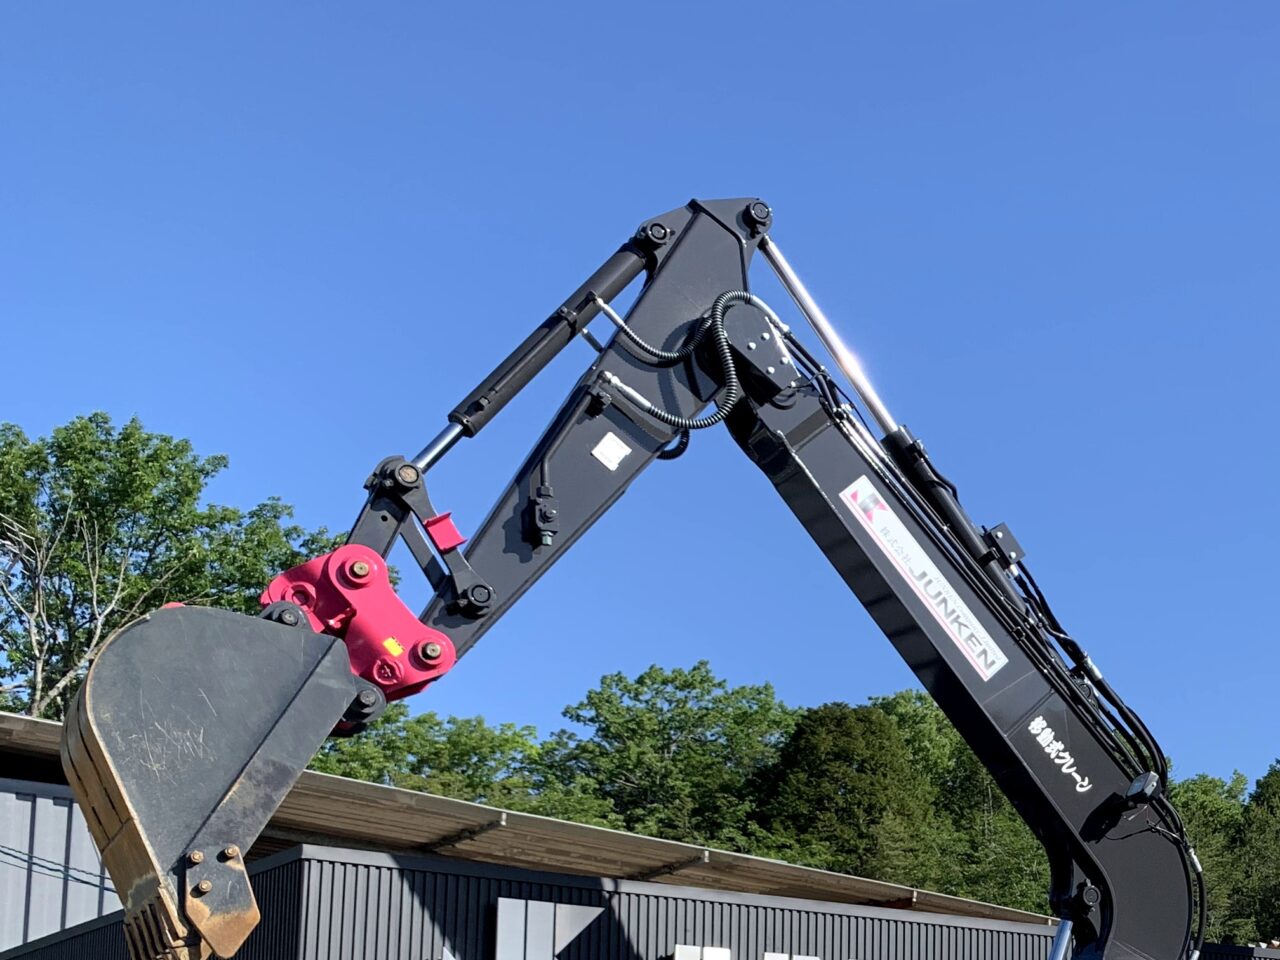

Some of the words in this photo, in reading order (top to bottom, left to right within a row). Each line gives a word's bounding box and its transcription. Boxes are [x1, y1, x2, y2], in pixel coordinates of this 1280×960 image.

[908, 571, 996, 670] JUNKEN
[1028, 715, 1093, 794] 移動式クレーン
